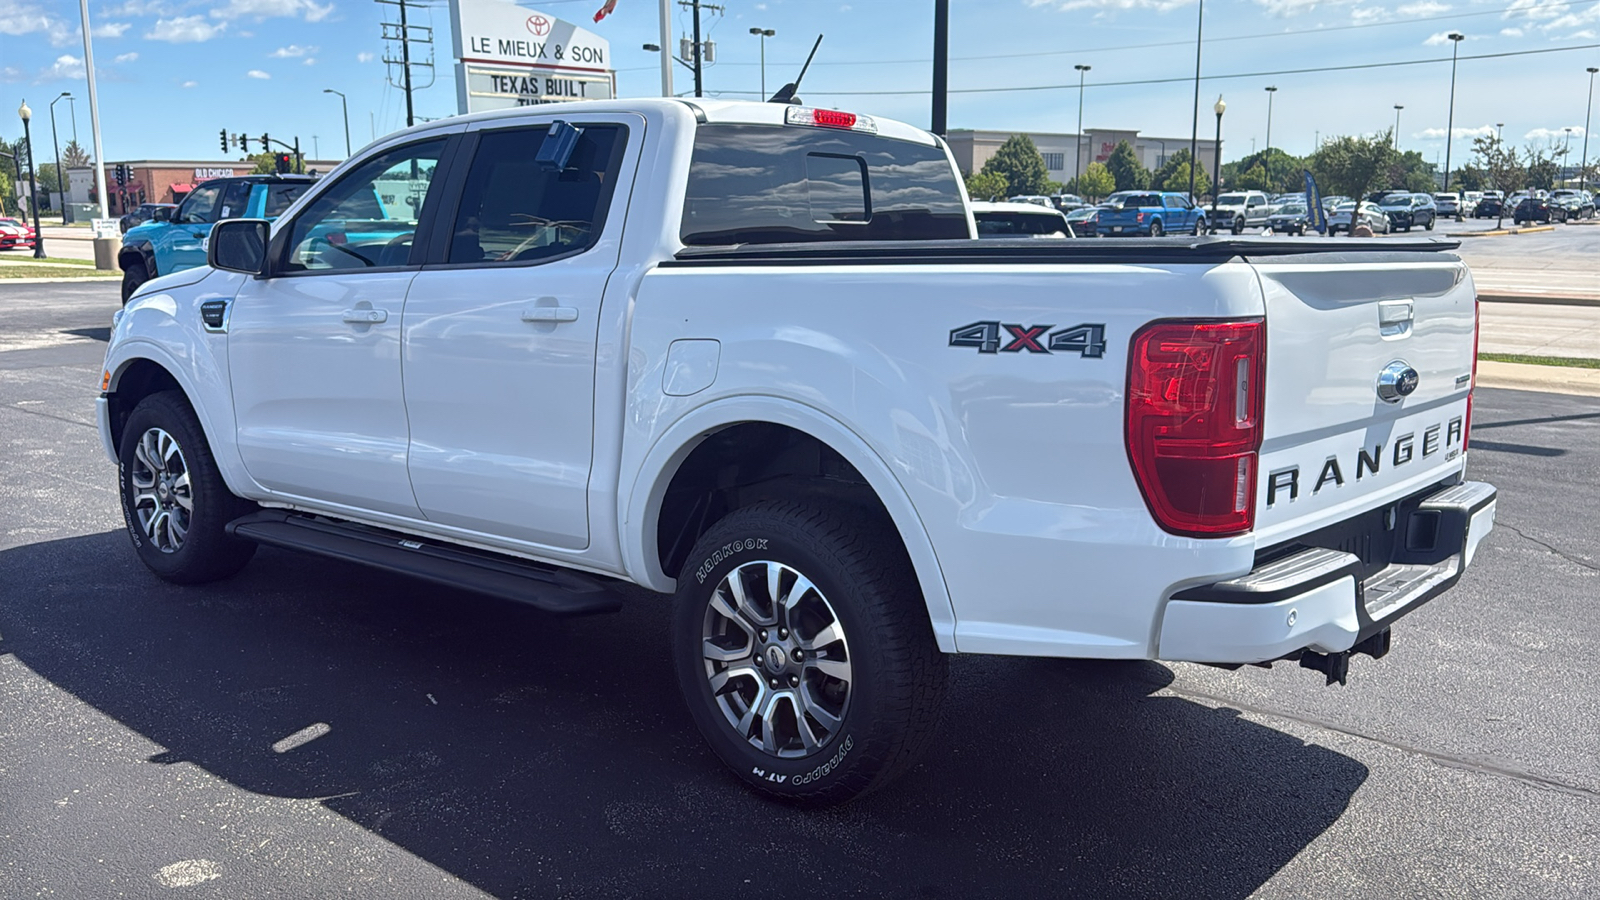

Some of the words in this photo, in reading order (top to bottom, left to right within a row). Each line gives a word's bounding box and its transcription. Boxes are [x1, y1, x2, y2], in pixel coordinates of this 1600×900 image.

[471, 36, 491, 54] LE
[498, 39, 548, 59] MIEUX
[554, 44, 565, 60] &
[571, 45, 604, 64] SON
[491, 75, 539, 95] TEXAS
[546, 78, 587, 97] BUILT
[195, 168, 208, 178] OLD
[208, 168, 234, 178] CHICAGO
[1266, 415, 1462, 510] RANGER
